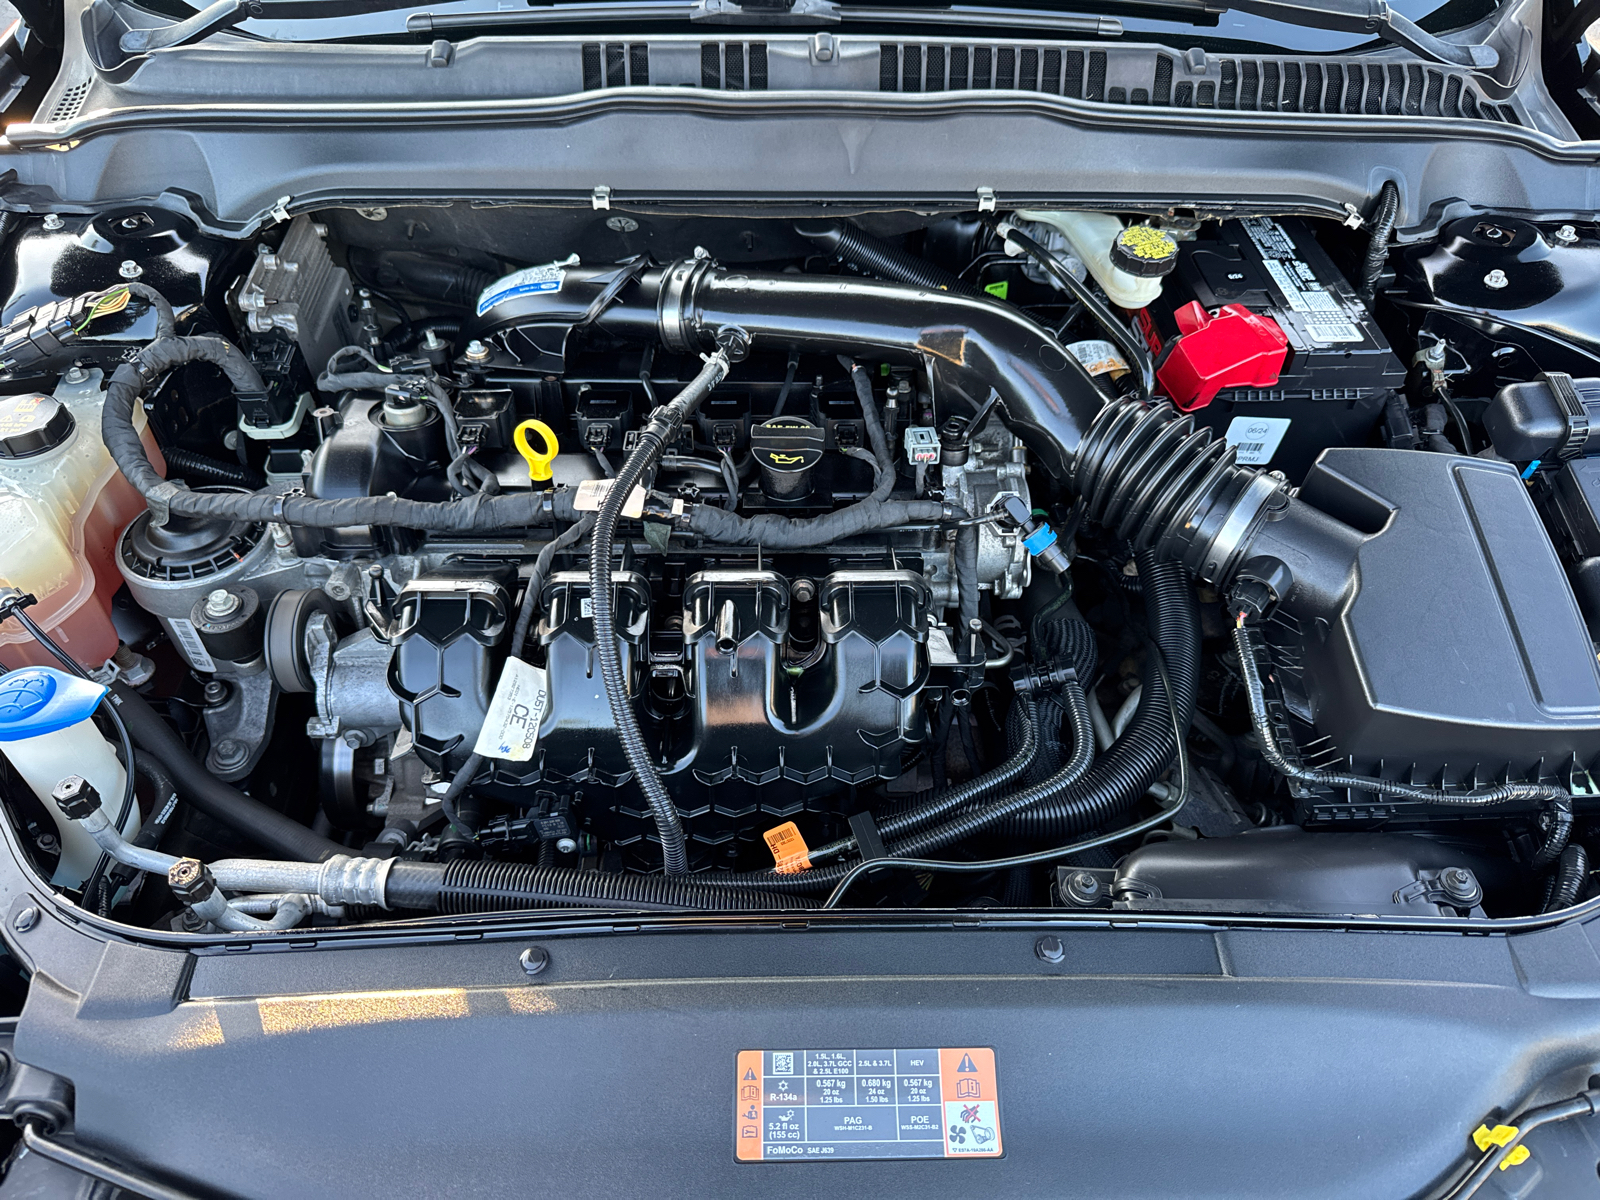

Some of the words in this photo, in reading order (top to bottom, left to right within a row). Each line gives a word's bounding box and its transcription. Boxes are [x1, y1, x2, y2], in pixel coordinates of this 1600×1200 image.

[1137, 307, 1162, 357] SUP
[510, 704, 529, 729] CE
[837, 1079, 846, 1089] kg
[882, 1079, 891, 1088] kg
[924, 1079, 932, 1088] kg
[769, 1131, 786, 1140] (155
[788, 1131, 800, 1140] cc)
[767, 1146, 803, 1154] FoMoCo
